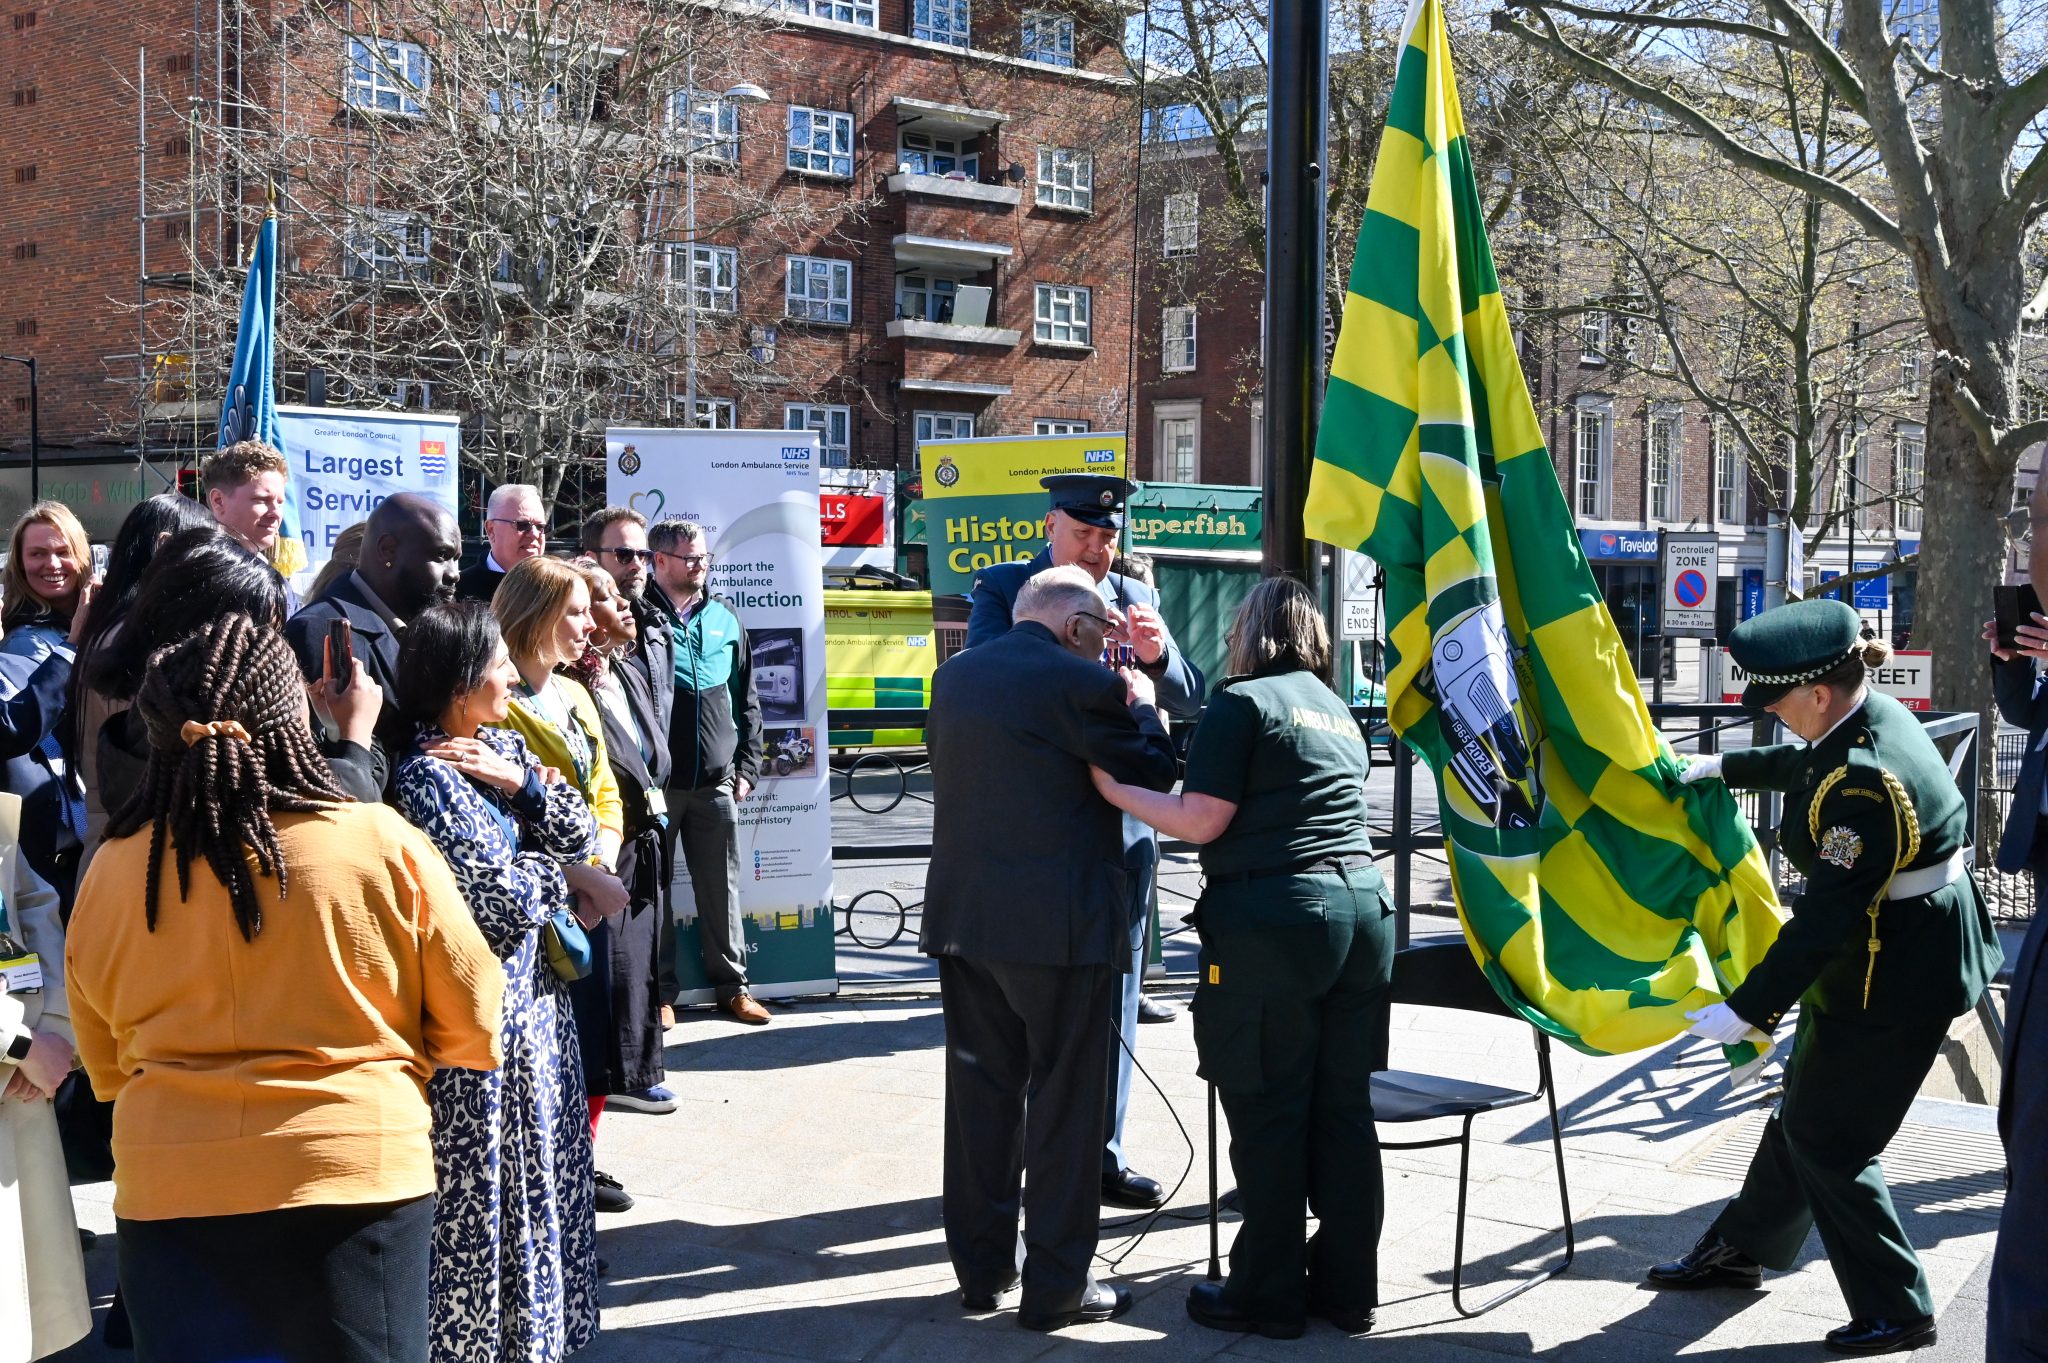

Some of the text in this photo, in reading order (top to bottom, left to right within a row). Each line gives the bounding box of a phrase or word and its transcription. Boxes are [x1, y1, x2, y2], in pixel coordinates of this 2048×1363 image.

[314, 428, 396, 440] Greater London Council
[782, 448, 809, 459] NHS
[1085, 450, 1113, 463] NHS
[305, 449, 404, 481] Largest
[711, 461, 810, 470] London Ambulance Service
[1008, 464, 1115, 477] London Ambulance Service
[41, 480, 87, 503] FOOD
[91, 479, 105, 506] &
[664, 511, 700, 521] London
[1670, 545, 1714, 554] Controlled
[1676, 556, 1707, 567] ZONE
[709, 561, 775, 575] support the
[710, 576, 773, 587] Ambulance
[871, 610, 894, 619] UNIT
[1351, 605, 1370, 615] Zone
[1347, 618, 1376, 629] ENDS
[847, 638, 882, 646] Ambulance
[907, 637, 926, 647] NHS
[1451, 720, 1494, 774] 1965 2025
[757, 793, 778, 802] visit:
